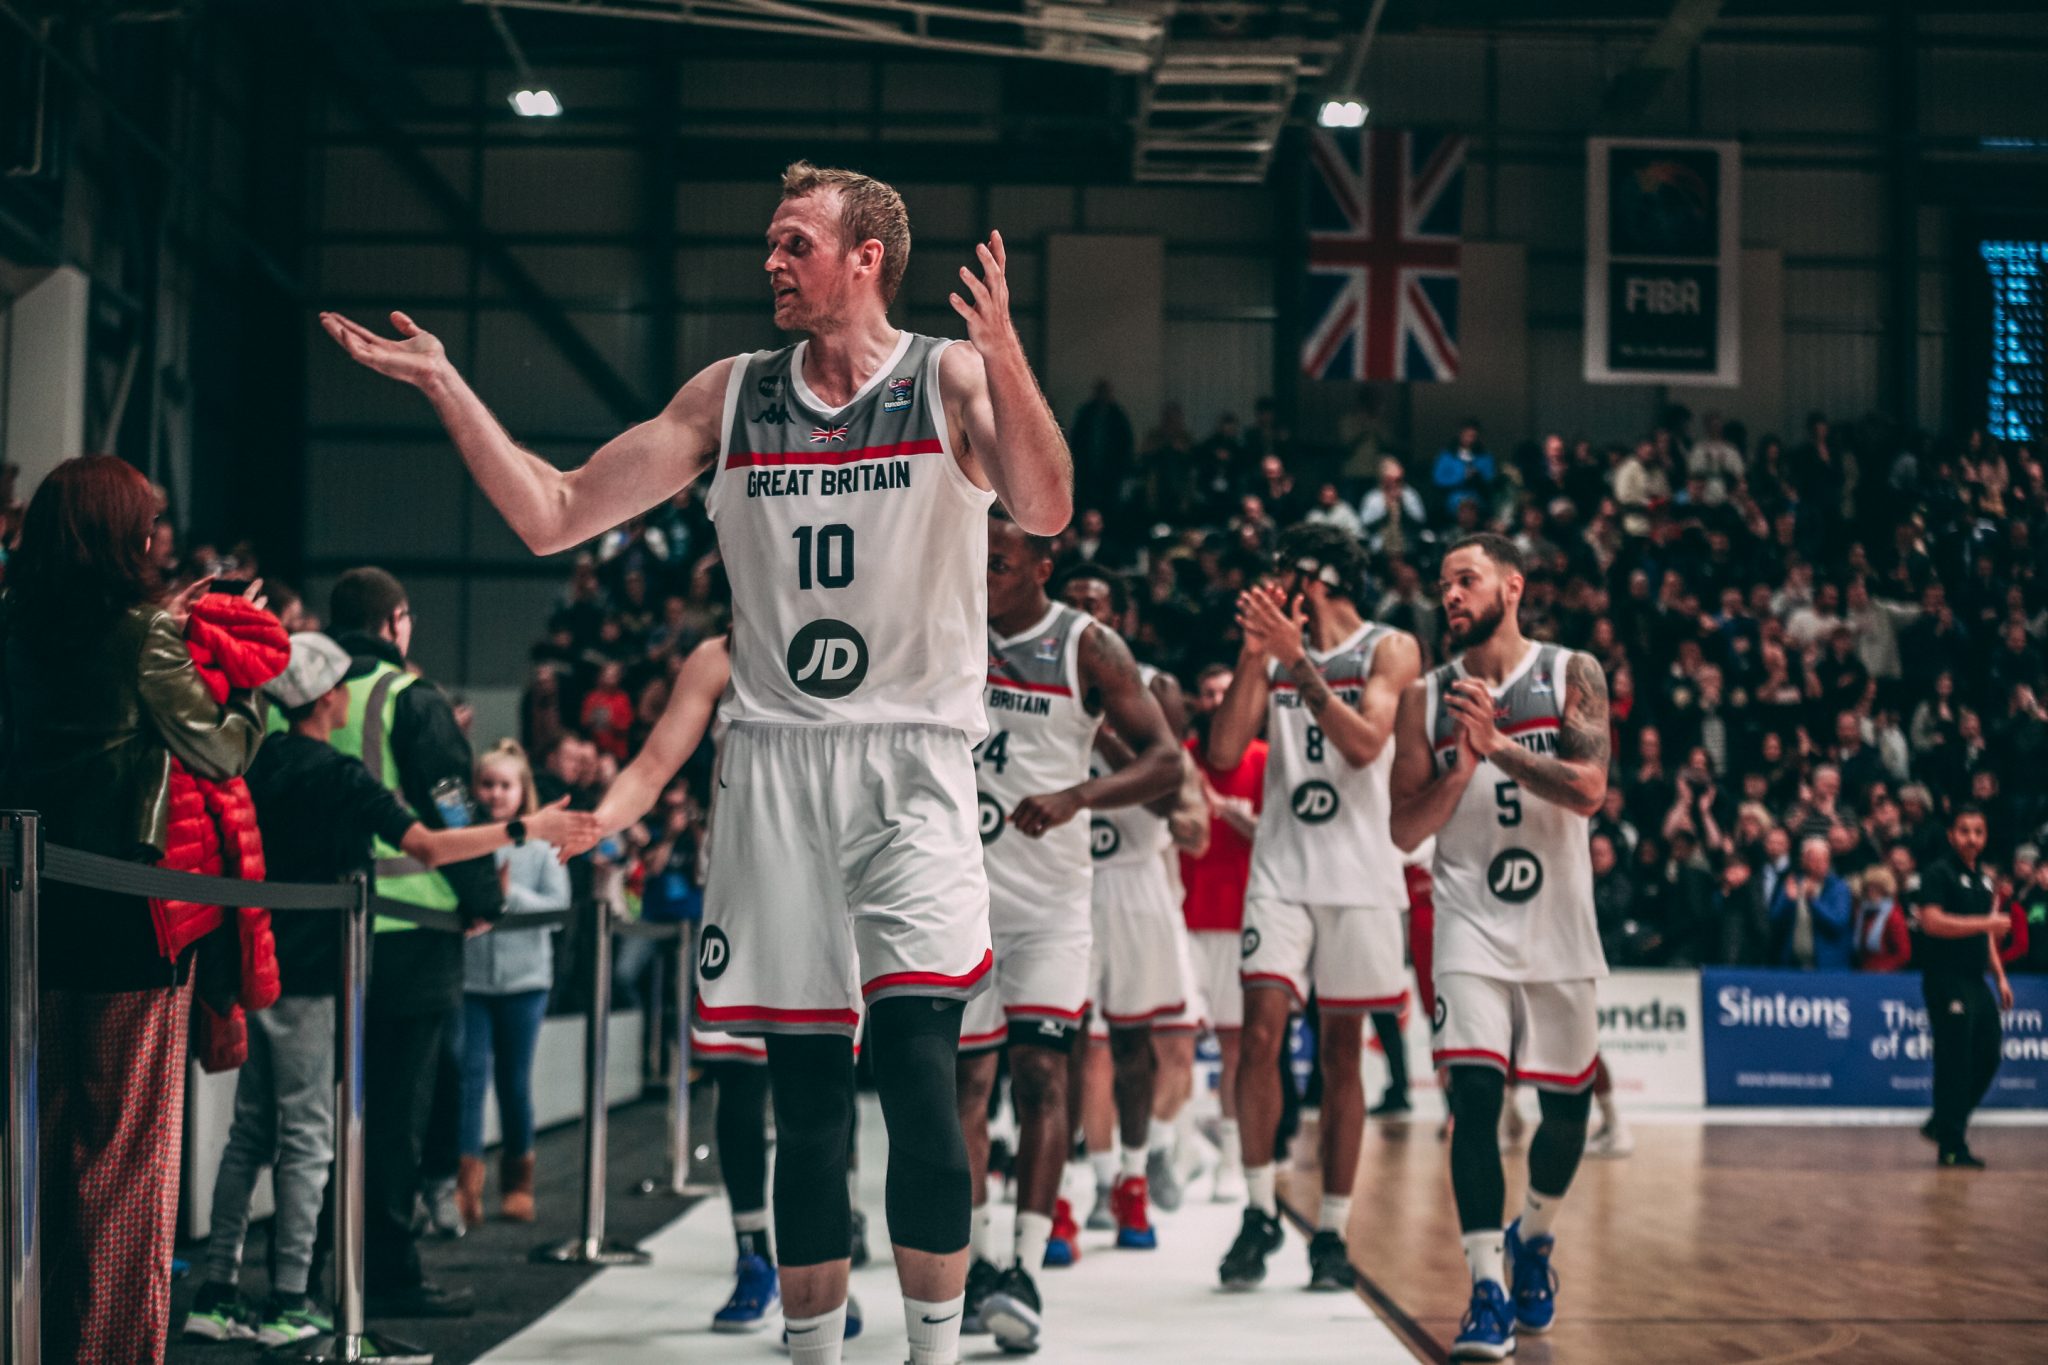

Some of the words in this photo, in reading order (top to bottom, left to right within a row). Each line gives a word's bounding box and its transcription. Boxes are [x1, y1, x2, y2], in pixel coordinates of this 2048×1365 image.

[1625, 276, 1700, 315] FIBA
[747, 470, 814, 499] GREAT
[820, 461, 911, 496] BRITAIN
[792, 523, 855, 590] 10
[796, 638, 859, 681] JD
[989, 689, 1051, 716] BRITAIN
[1306, 725, 1324, 762] 8
[1296, 789, 1334, 815] JD
[1495, 781, 1522, 827] 5
[1495, 859, 1537, 892] JD
[701, 938, 726, 967] JD
[1718, 986, 1851, 1028] Sintons
[1881, 1000, 1931, 1032] The
[1871, 1032, 1899, 1060] of
